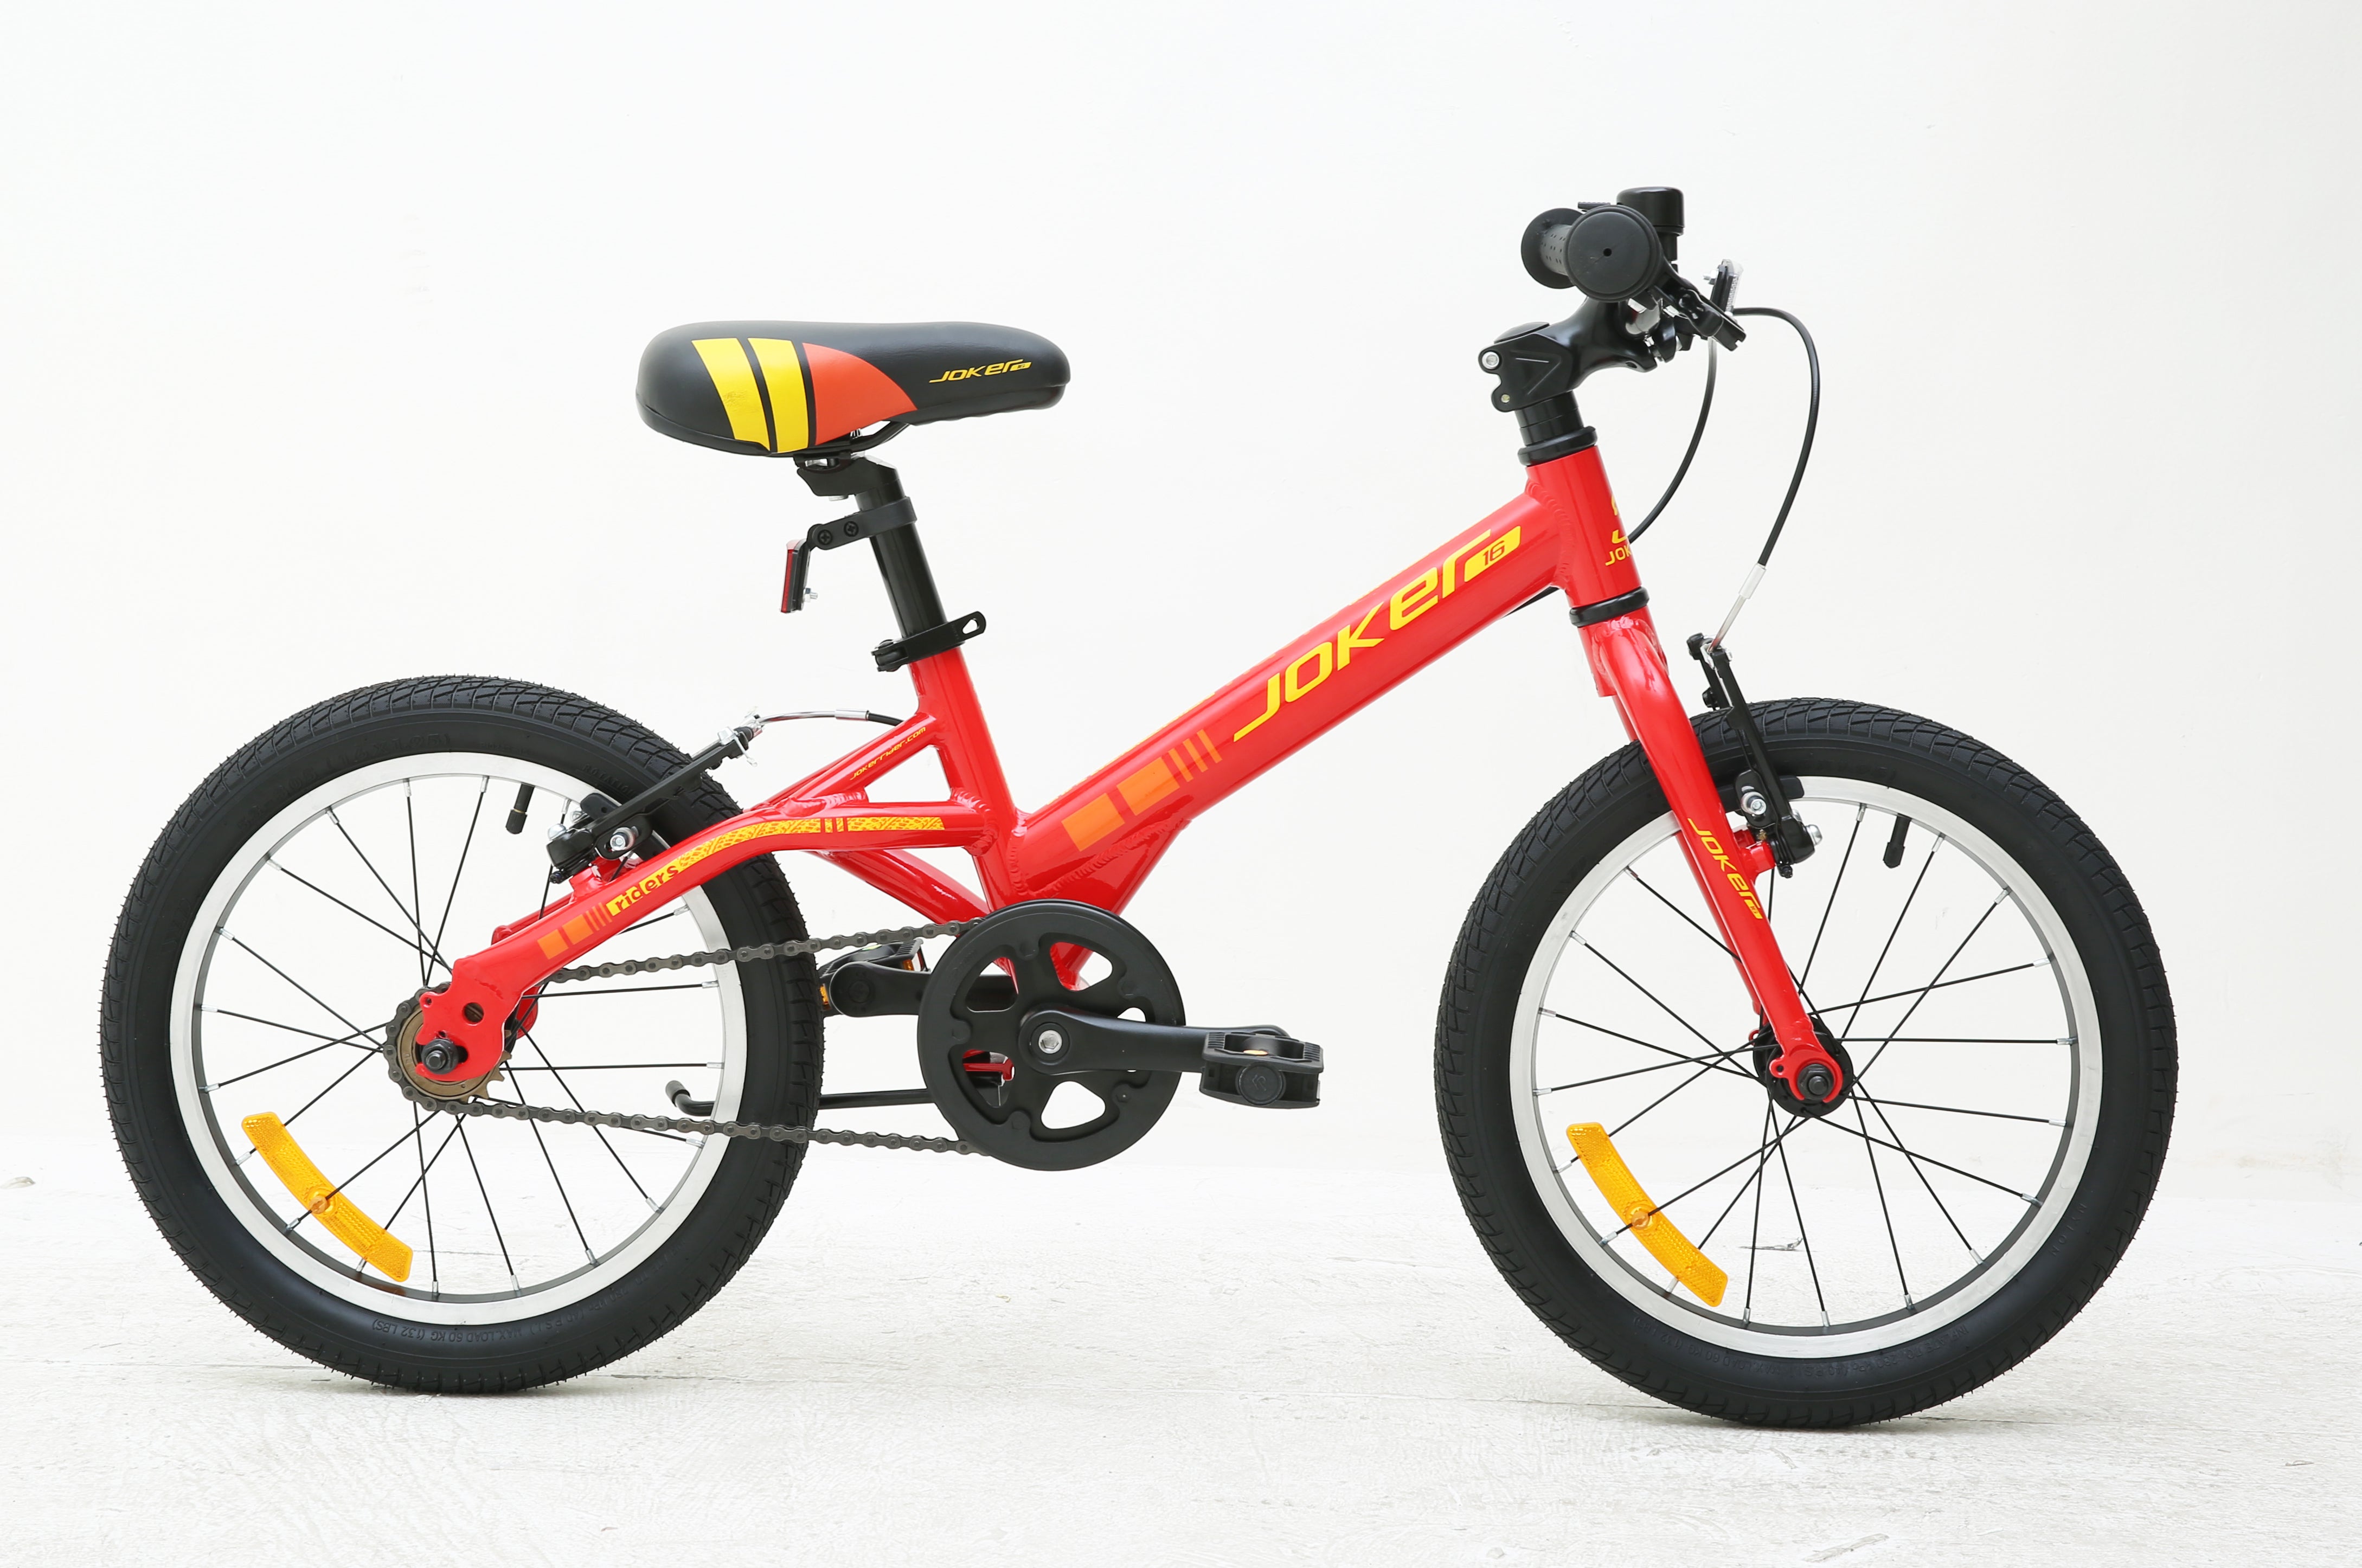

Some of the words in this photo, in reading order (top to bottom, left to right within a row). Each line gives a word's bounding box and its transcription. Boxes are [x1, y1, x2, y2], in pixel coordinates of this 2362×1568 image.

[1483, 541, 1505, 565] 16
[370, 1318, 399, 1335] LBS)
[400, 1325, 426, 1340] (132
[430, 1329, 446, 1342] KG
